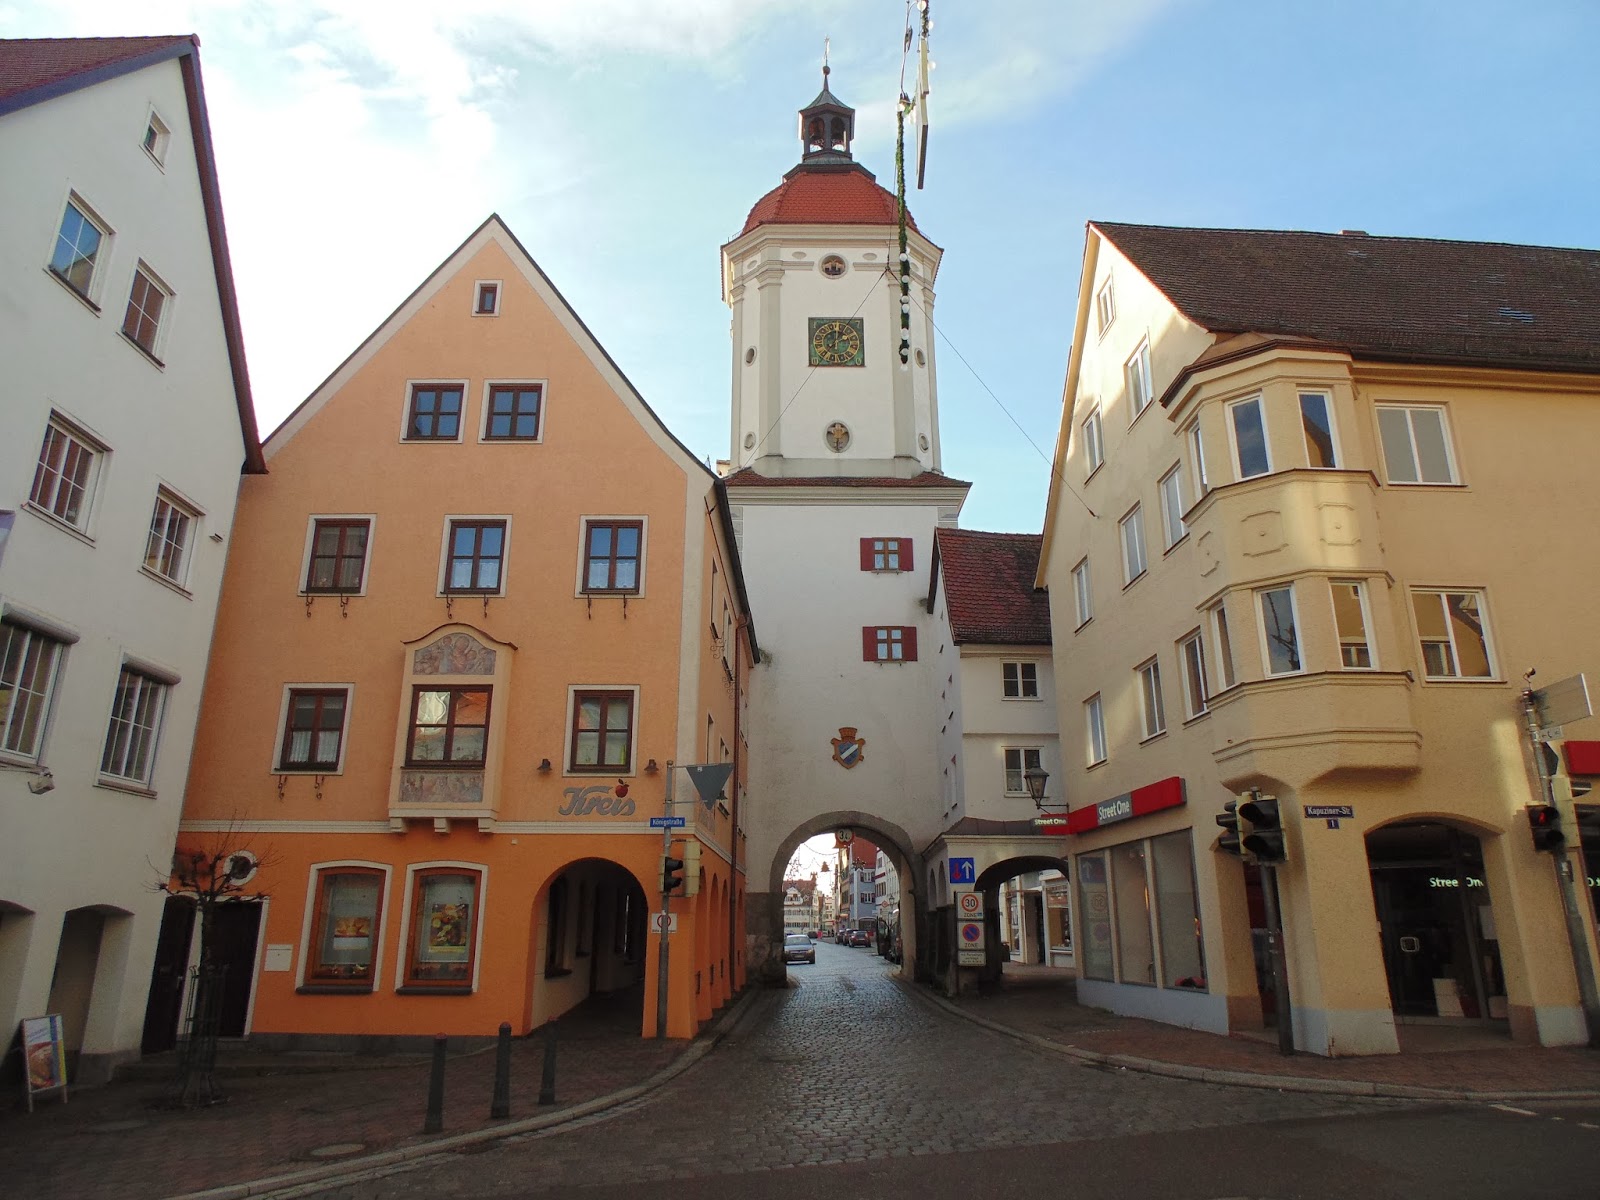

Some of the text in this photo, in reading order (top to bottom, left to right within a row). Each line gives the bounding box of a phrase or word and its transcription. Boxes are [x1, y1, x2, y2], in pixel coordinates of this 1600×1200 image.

[558, 784, 636, 816] Kreis
[1098, 800, 1130, 821] Street One
[652, 818, 683, 826] Königstraße
[1429, 876, 1459, 888] Stree
[964, 898, 976, 908] 30
